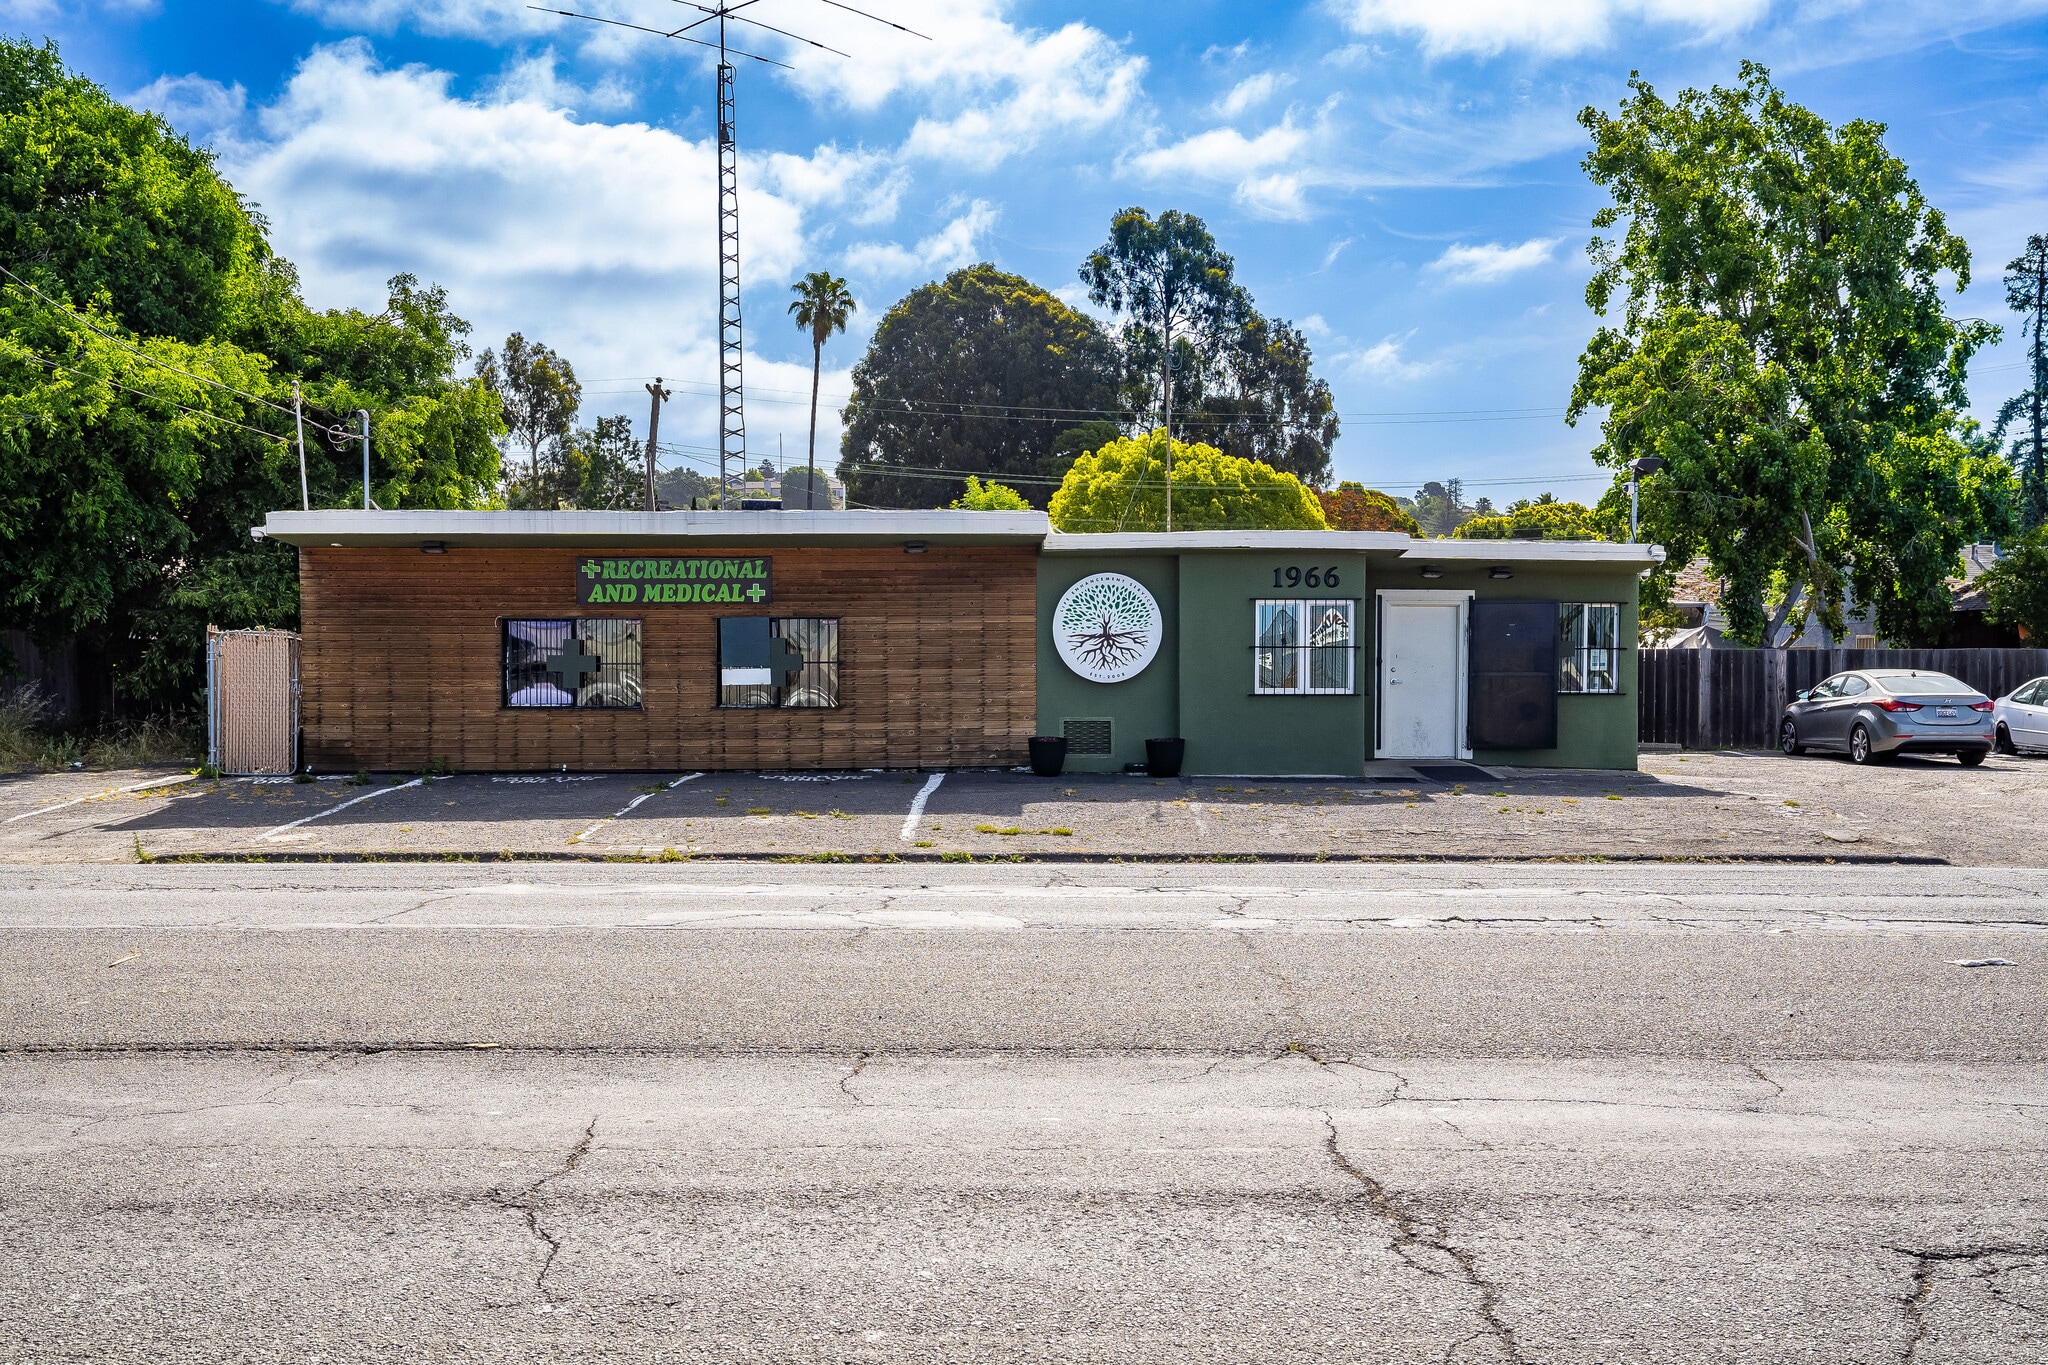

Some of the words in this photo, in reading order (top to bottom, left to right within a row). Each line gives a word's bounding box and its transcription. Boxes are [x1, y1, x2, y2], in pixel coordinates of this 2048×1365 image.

[602, 560, 767, 579] RECREATIONAL
[1273, 566, 1341, 588] 1966
[587, 584, 637, 603] AND
[642, 584, 745, 603] MEDICAL
[1071, 577, 1125, 595] ENHANCEMENT
[1129, 582, 1155, 611] SERVICES
